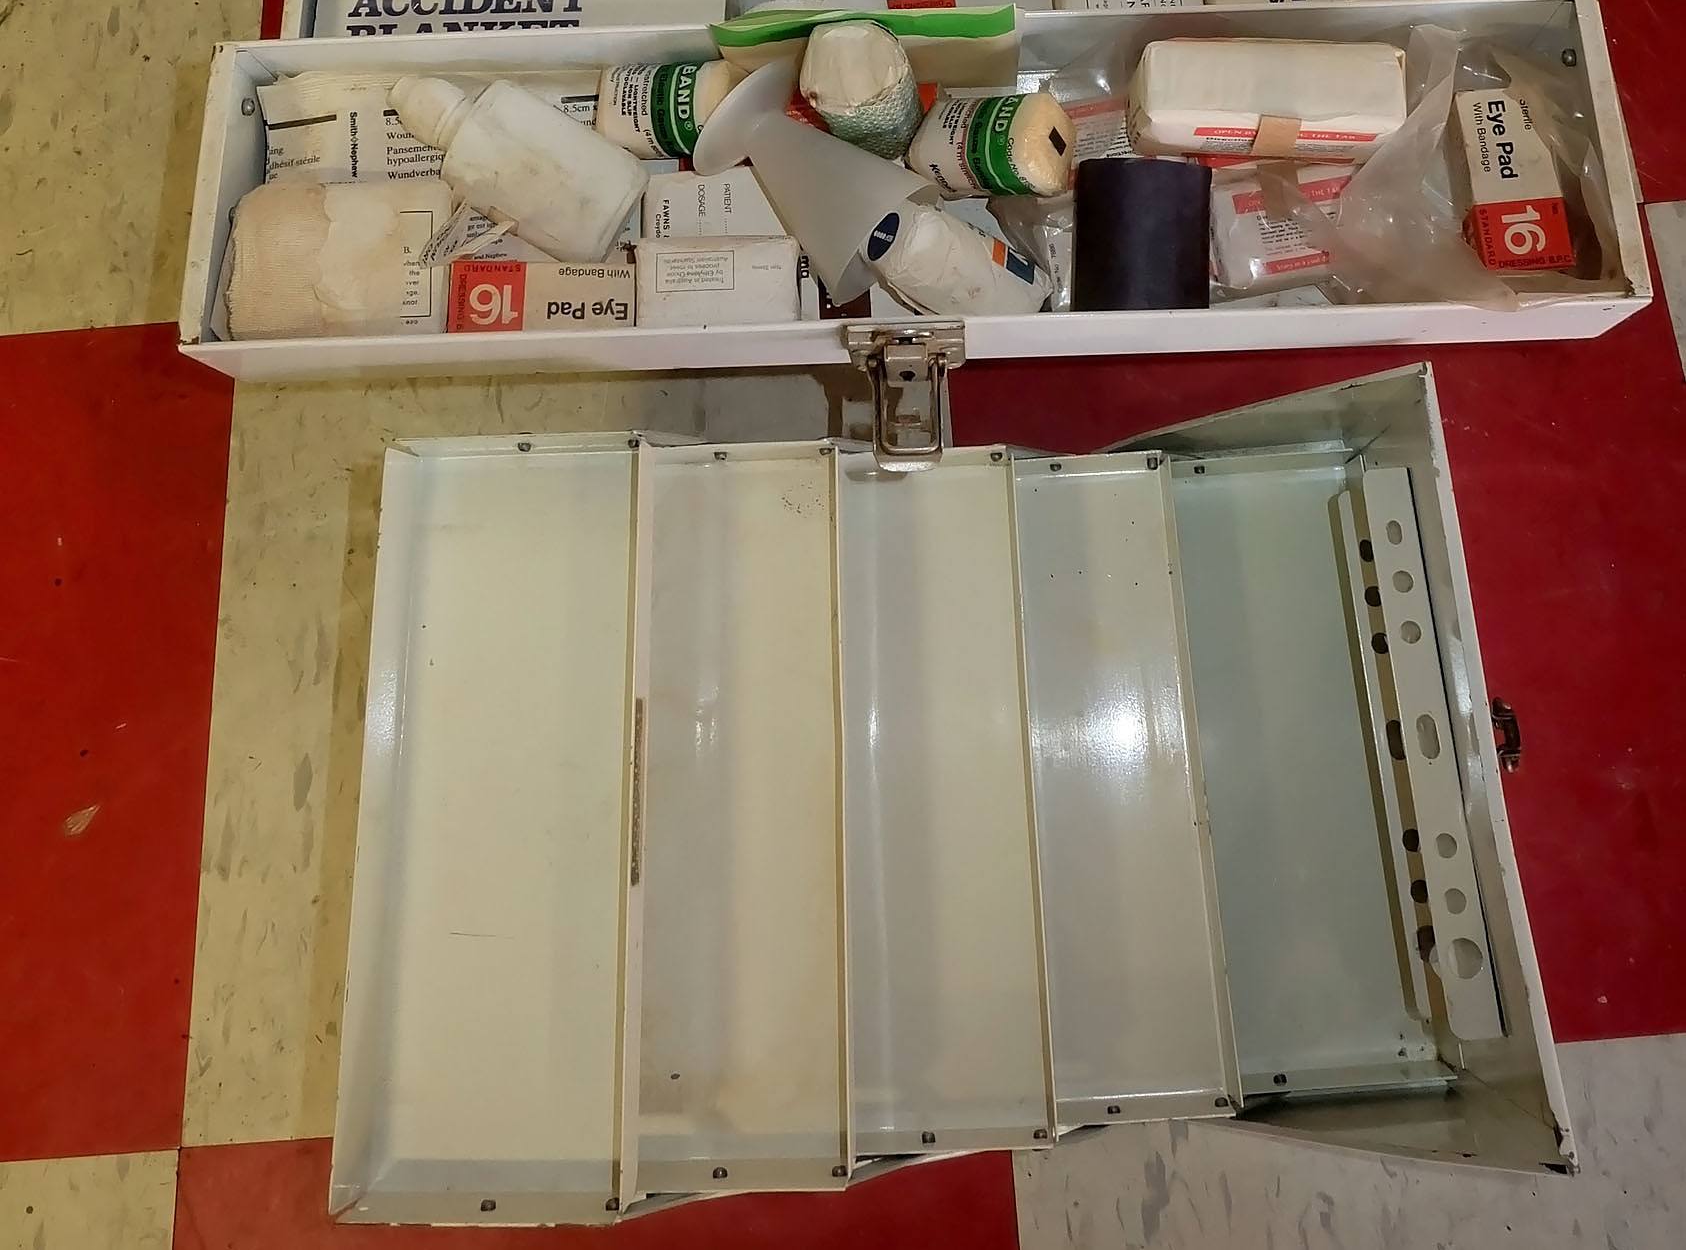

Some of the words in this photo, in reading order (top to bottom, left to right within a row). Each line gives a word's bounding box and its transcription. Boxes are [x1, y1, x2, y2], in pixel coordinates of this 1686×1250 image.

[1472, 102, 1483, 126] With
[1487, 100, 1506, 137] Eye
[1477, 127, 1491, 173] Bandage
[1496, 141, 1519, 179] Pad
[697, 184, 706, 217] DOSAGE
[723, 183, 733, 214] PATIENT
[663, 199, 671, 230] FAWNS
[1501, 204, 1546, 255] 16
[1479, 209, 1496, 266] STANDARD
[464, 264, 521, 273] STANDARD
[558, 268, 604, 278] Bandage
[607, 269, 631, 279] With
[1499, 256, 1546, 269] DRESSING
[457, 273, 468, 320] DRESSING
[469, 283, 518, 325] 16
[546, 301, 585, 320] Pad
[592, 299, 628, 320] Eye
